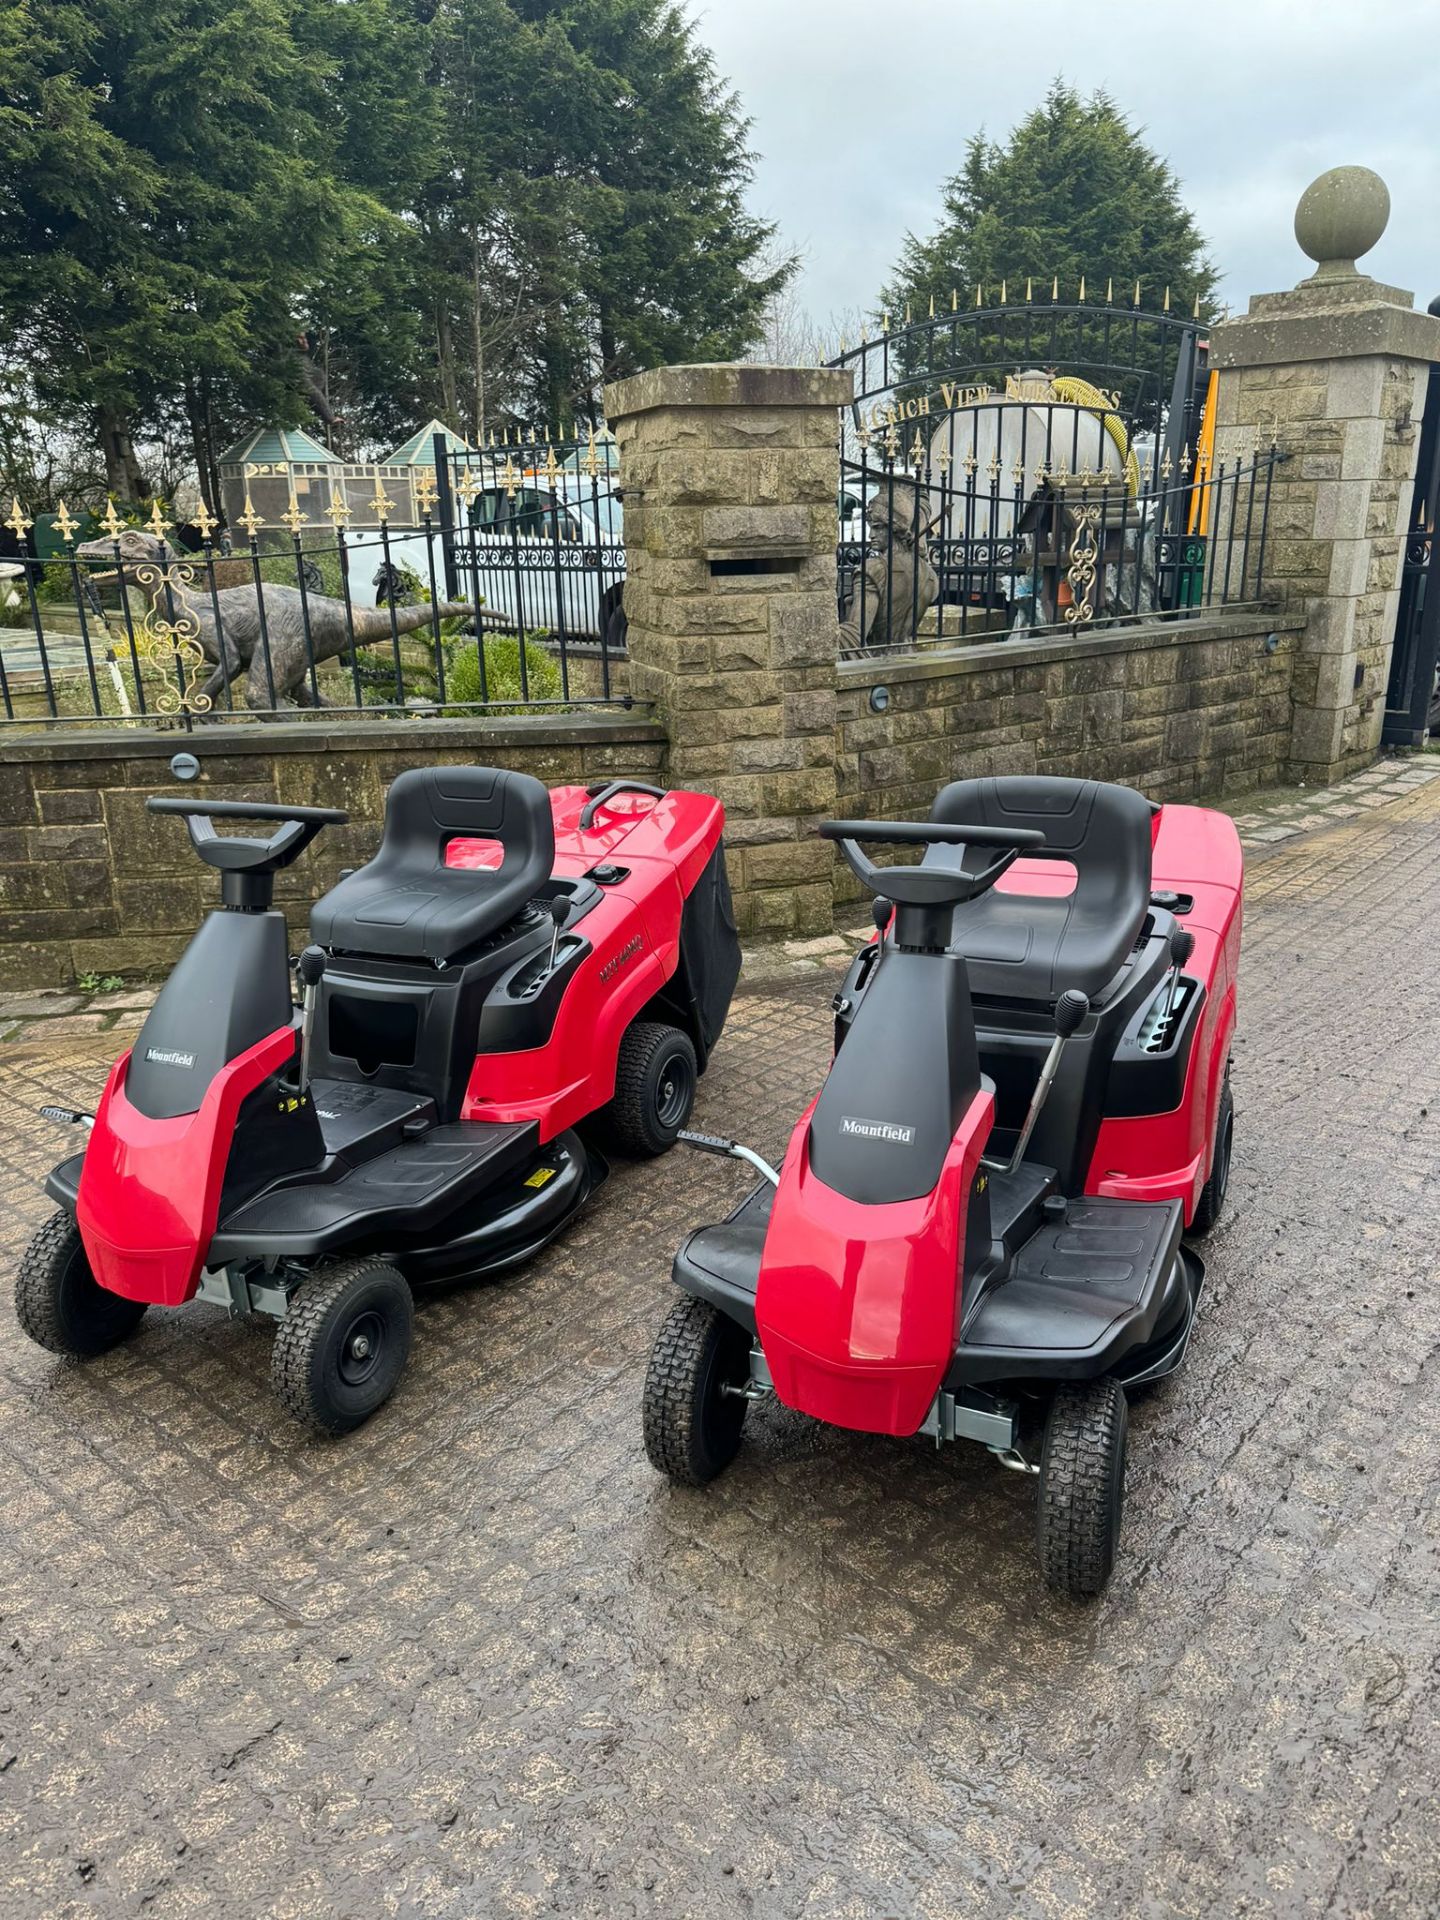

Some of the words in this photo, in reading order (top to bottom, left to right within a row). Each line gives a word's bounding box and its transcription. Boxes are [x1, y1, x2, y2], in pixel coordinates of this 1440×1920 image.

[940, 381, 991, 409] VIEW
[146, 1048, 193, 1066] Mountfield
[842, 1119, 911, 1142] Mountfield
